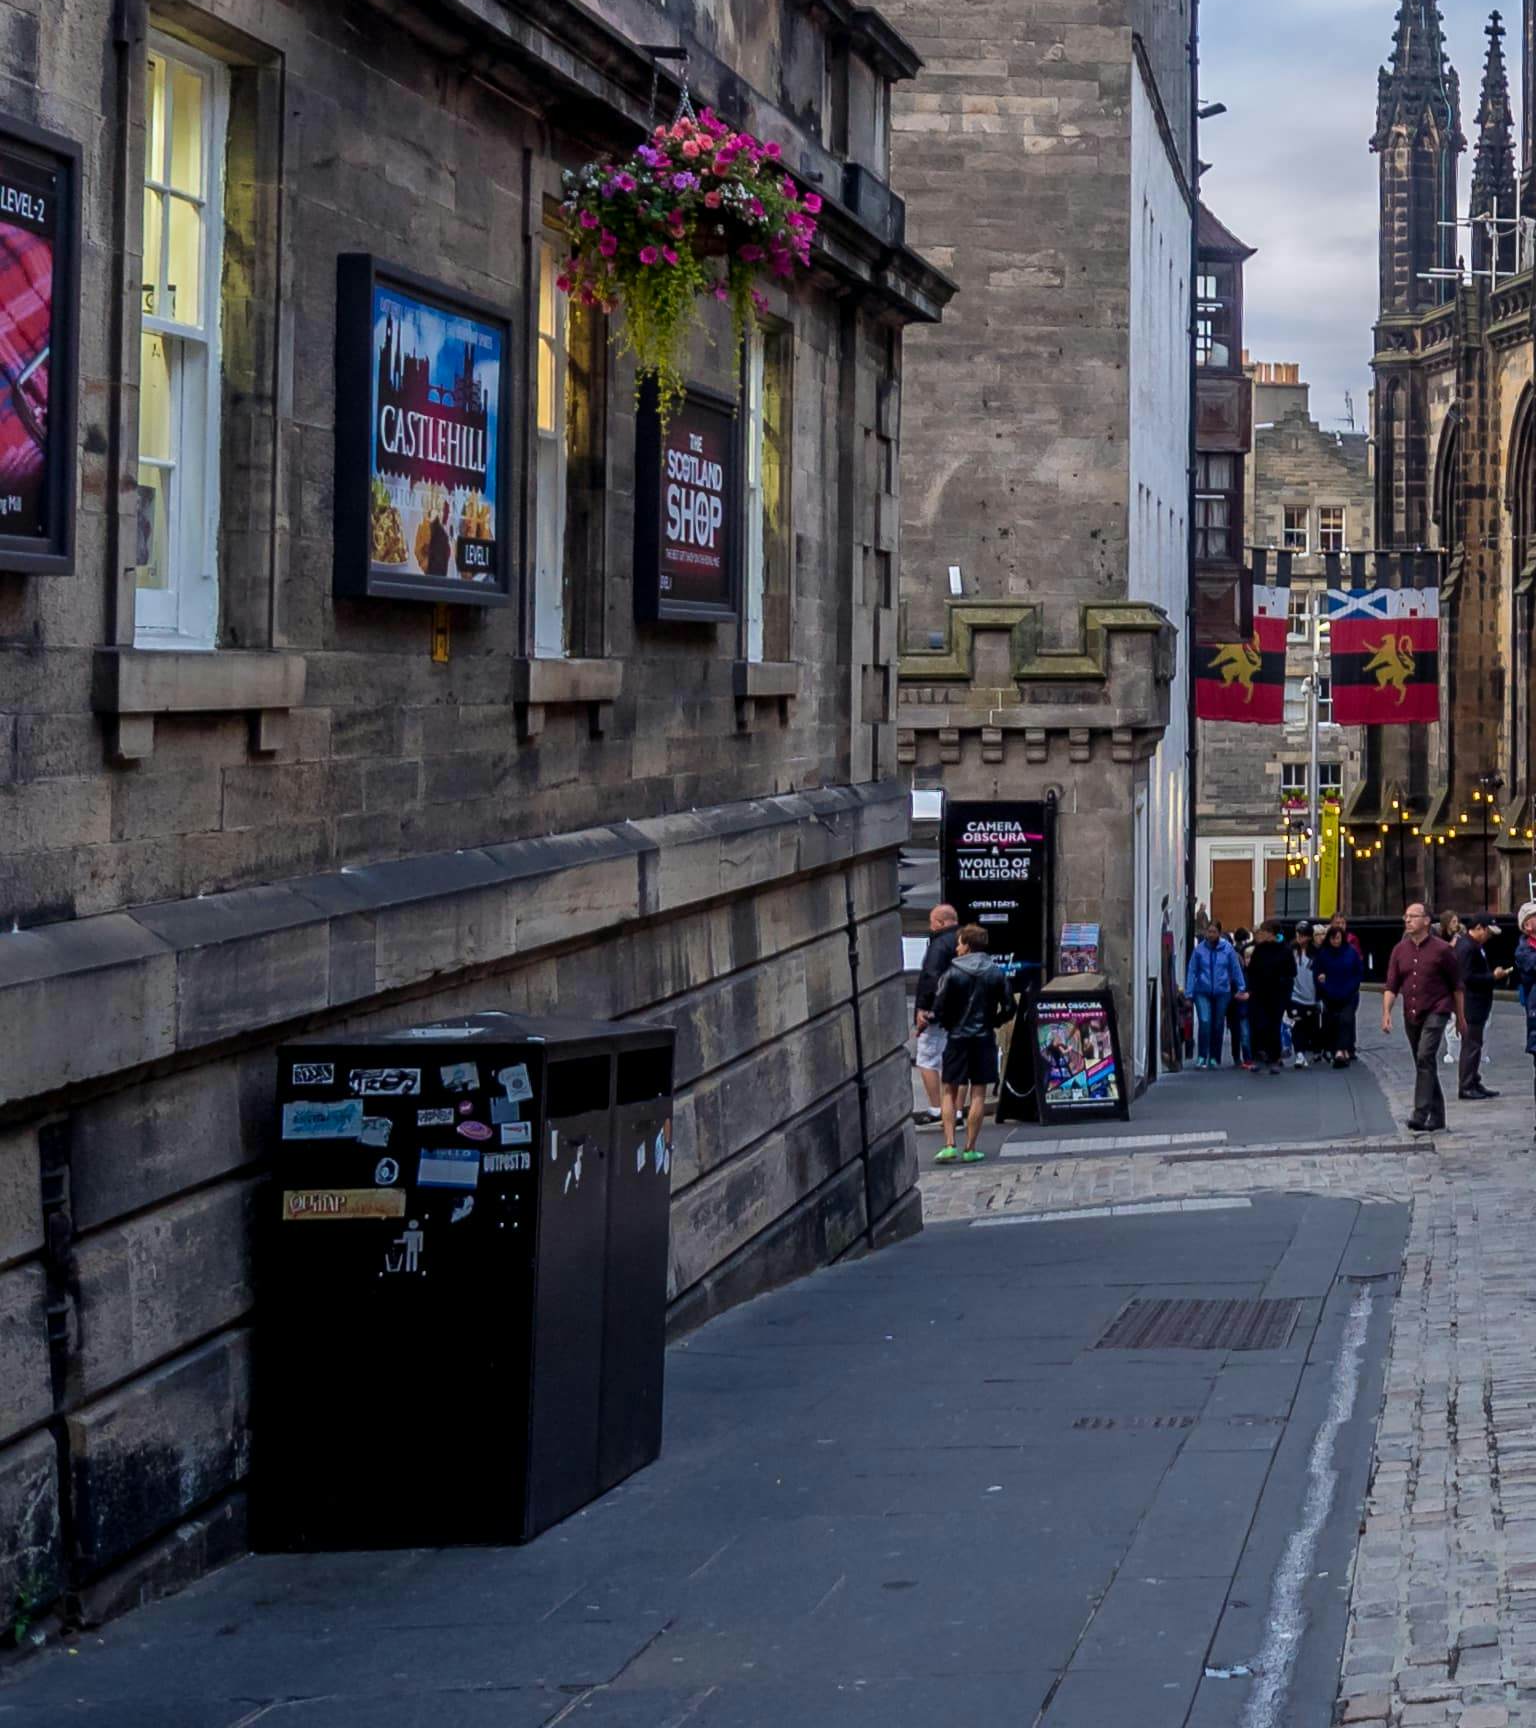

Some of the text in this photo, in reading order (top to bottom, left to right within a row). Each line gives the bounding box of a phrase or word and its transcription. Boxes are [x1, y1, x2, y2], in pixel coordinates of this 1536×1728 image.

[380, 403, 487, 473] CASTLEHILL
[689, 432, 704, 453] THE
[667, 448, 723, 492] SCOTLAND
[666, 483, 723, 549] SHOP
[967, 821, 1022, 832] CAMERA
[962, 832, 1027, 843] OBSCURA
[991, 846, 999, 855] &
[959, 857, 1031, 869] WORLD OF
[959, 869, 1029, 880] ILLUSIONS
